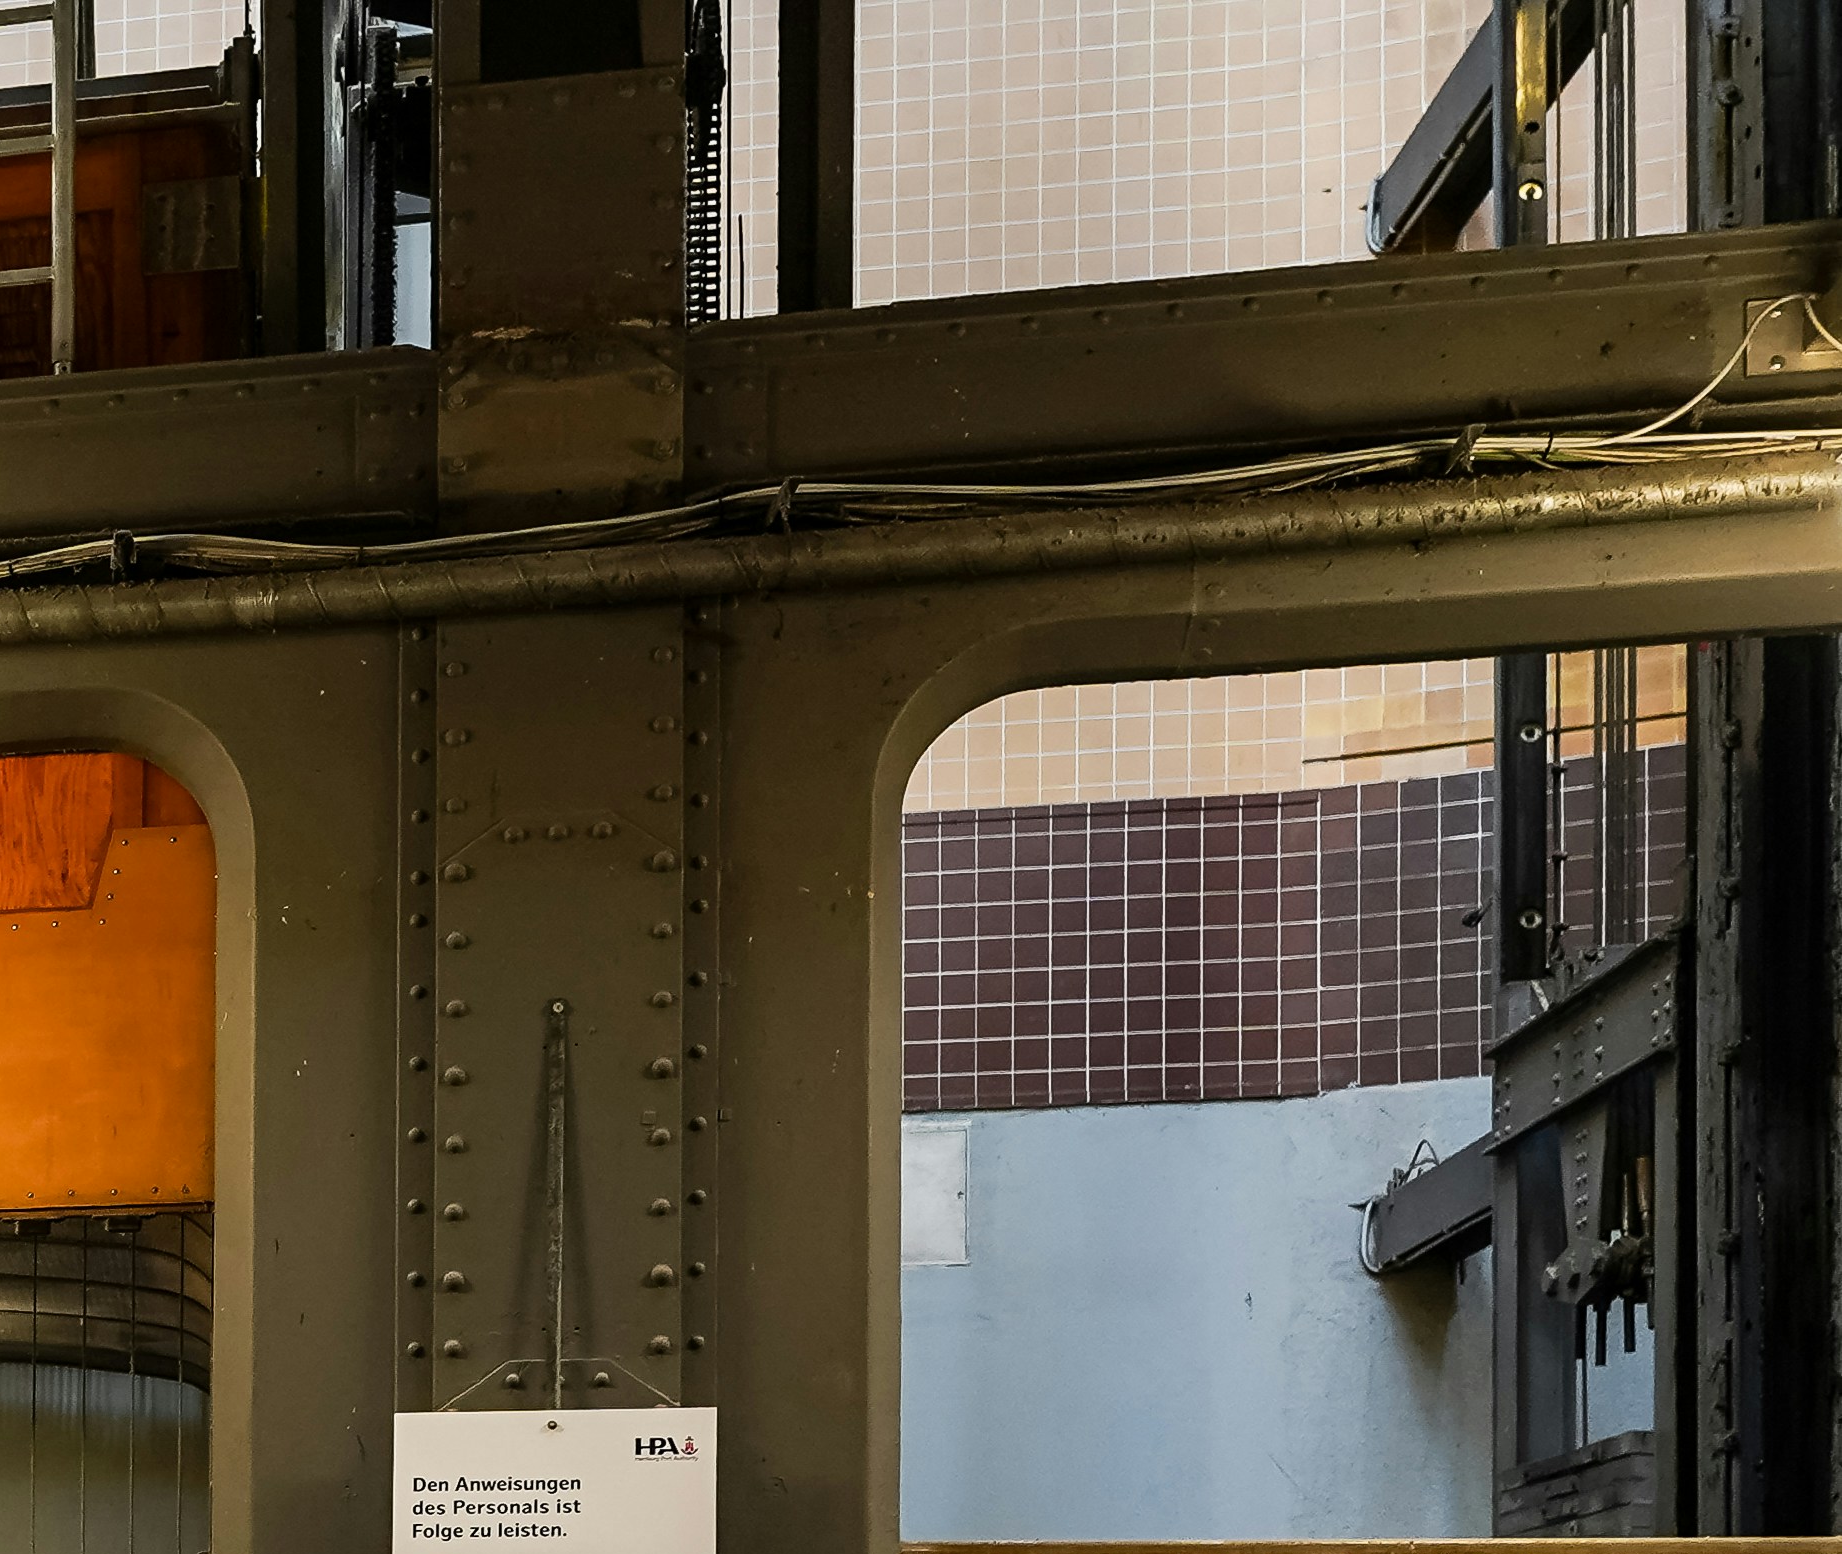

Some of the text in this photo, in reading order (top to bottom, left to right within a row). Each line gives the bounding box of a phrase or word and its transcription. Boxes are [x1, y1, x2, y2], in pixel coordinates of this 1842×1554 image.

[634, 1437, 680, 1456] HPA
[412, 1476, 581, 1495] Den Anweisungen
[412, 1498, 582, 1516] des Personals ist
[412, 1522, 568, 1542] Folge zu leisten.
